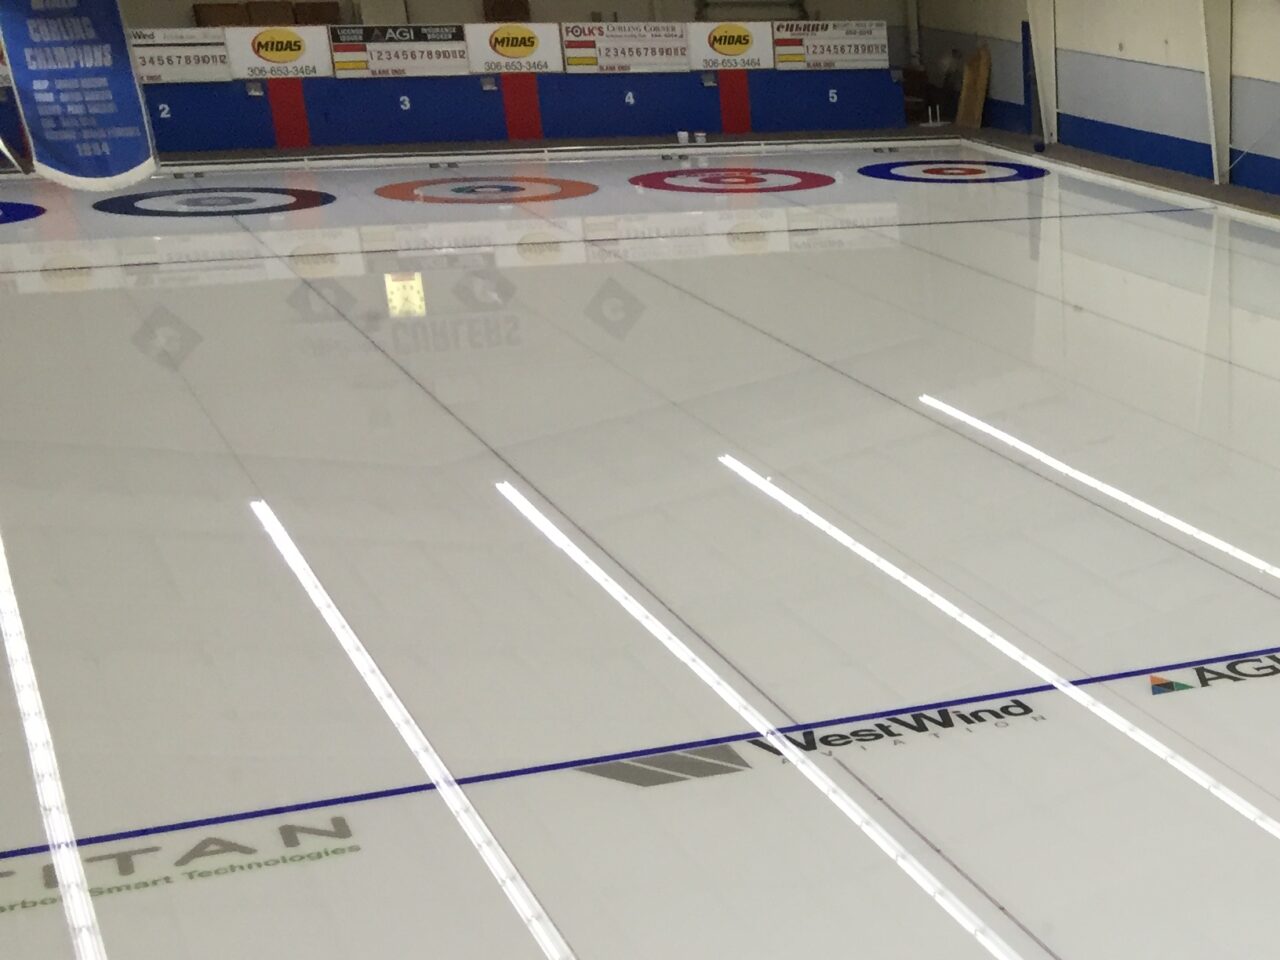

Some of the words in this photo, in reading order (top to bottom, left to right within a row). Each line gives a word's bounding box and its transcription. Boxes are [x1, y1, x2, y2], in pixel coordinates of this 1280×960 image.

[385, 28, 415, 40] AGI
[565, 25, 605, 37] FOLK'S
[256, 38, 302, 53] MIDAS
[494, 33, 536, 48] MIDAS
[713, 31, 750, 46] MIDAS
[400, 96, 411, 110] 3
[625, 91, 635, 105] 4
[829, 90, 837, 102] 5
[159, 104, 171, 118] 2
[747, 699, 1035, 757] WestWind
[0, 816, 353, 889] ITAN
[88, 875, 174, 899] Smart
[182, 843, 362, 881] Technologies
